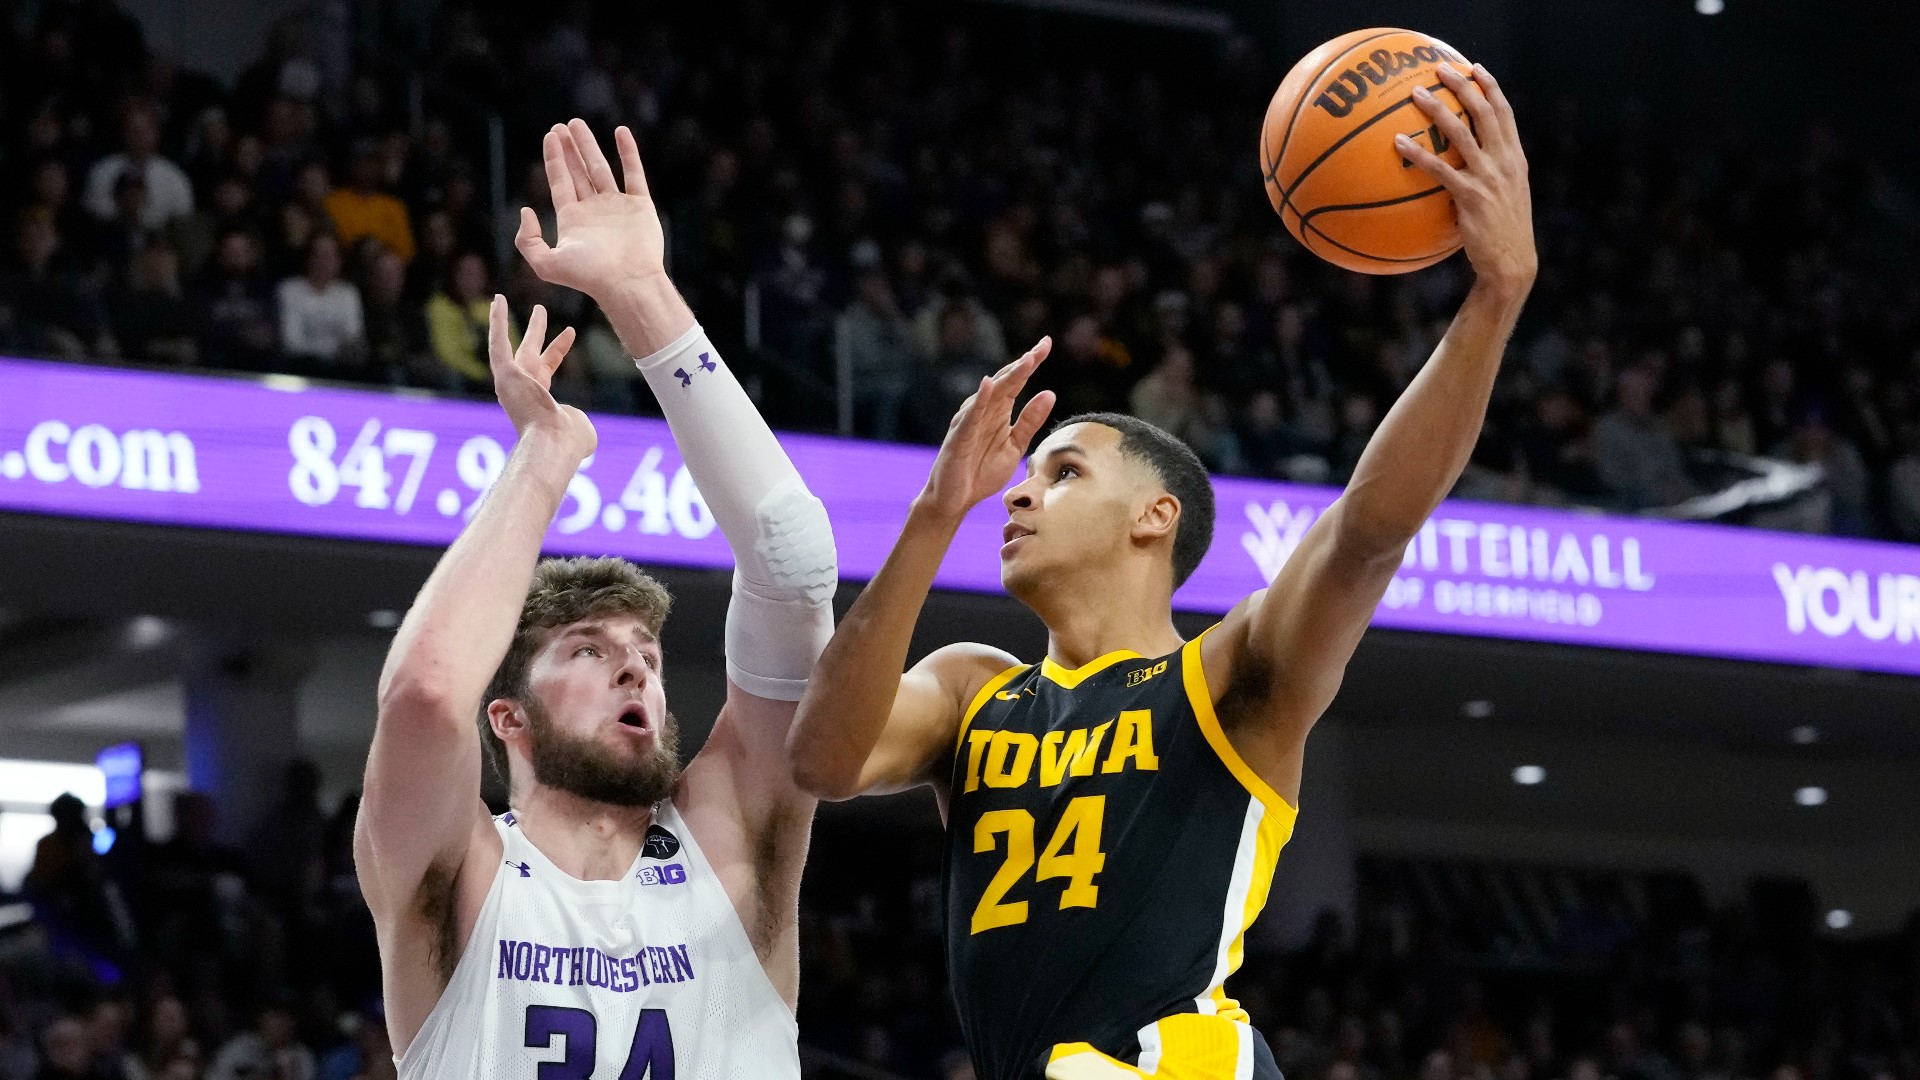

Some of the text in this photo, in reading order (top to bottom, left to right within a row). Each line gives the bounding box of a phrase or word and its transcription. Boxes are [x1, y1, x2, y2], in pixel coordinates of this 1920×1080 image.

[1313, 44, 1464, 118] Wilson
[1, 420, 199, 494] .com
[1771, 561, 1920, 645] YOUR
[963, 708, 1159, 794] IOWA
[970, 795, 1105, 935] 24
[498, 939, 695, 993] NORTHWESTERN
